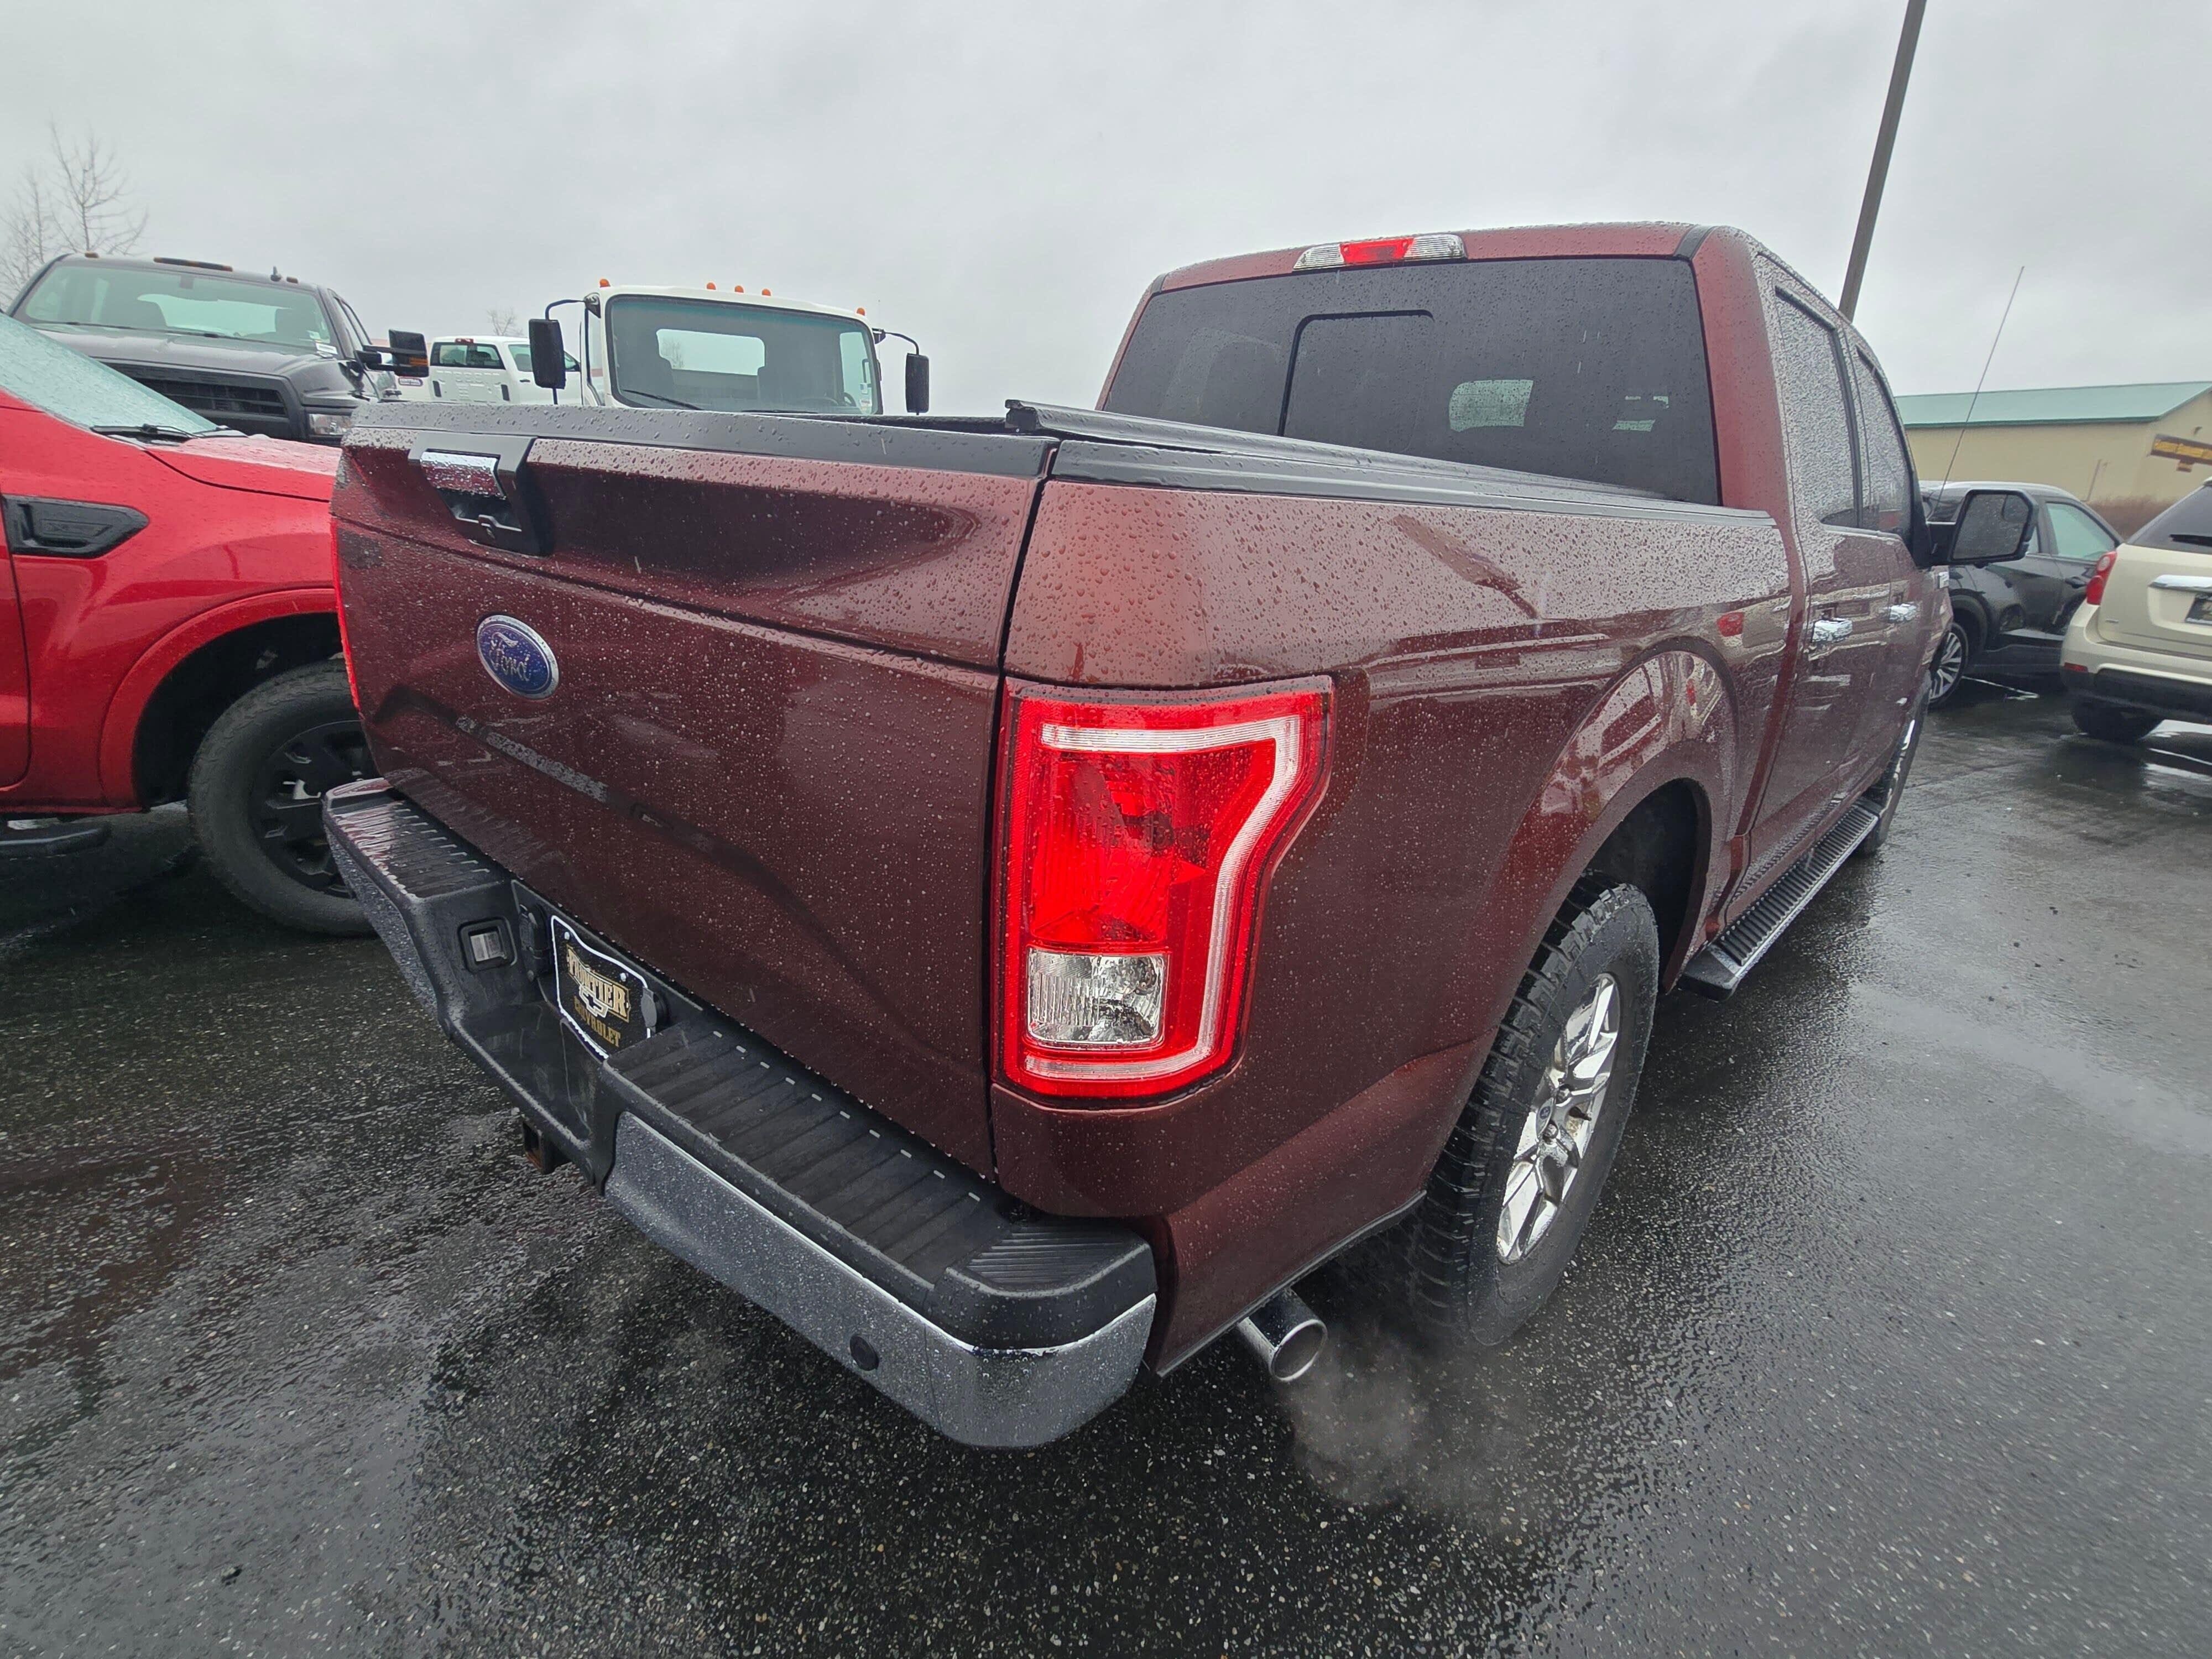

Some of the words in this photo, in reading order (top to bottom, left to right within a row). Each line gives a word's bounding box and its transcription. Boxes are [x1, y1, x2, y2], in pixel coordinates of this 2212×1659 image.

[488, 631, 531, 683] Ford
[567, 948, 627, 1018] FRONTIER
[573, 995, 621, 1047] CHEVROLET
